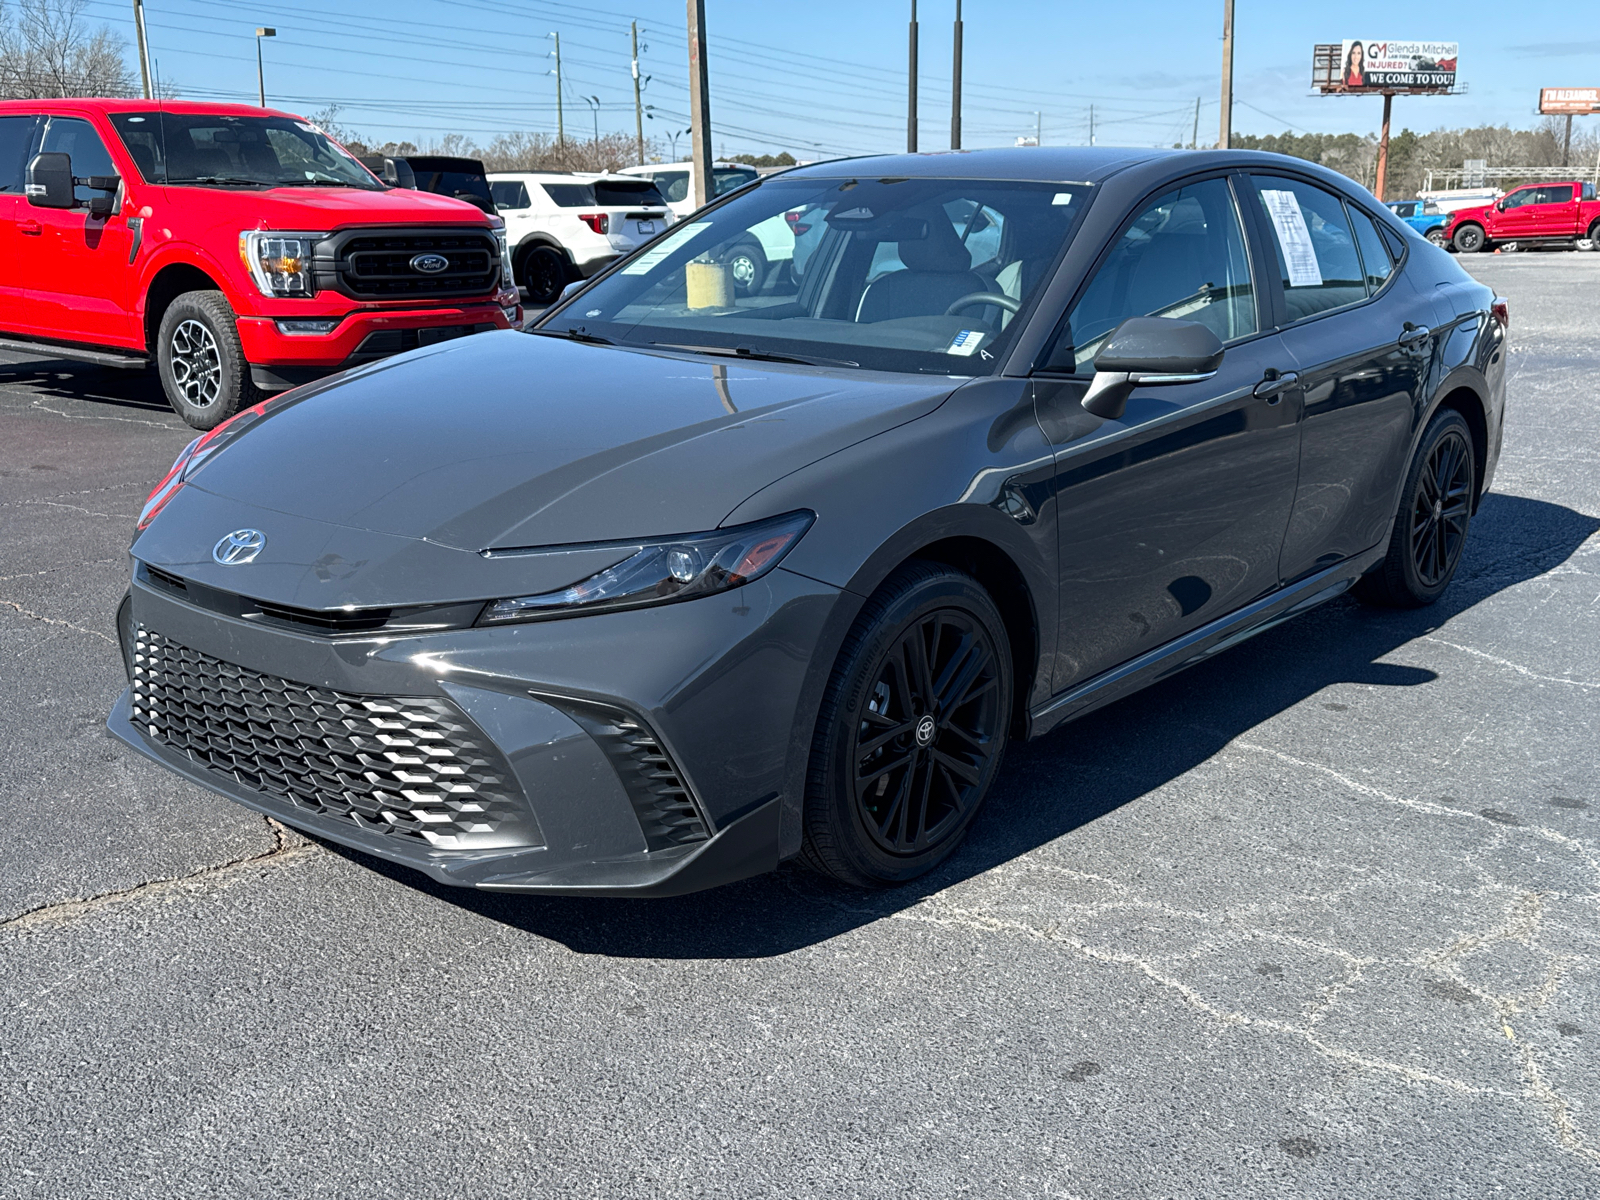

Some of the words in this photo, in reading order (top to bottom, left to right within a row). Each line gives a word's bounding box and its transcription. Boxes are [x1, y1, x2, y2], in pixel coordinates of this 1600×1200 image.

[1368, 43, 1387, 59] GM
[1388, 43, 1420, 54] Glenda
[1422, 44, 1458, 55] Mitchell
[1367, 61, 1408, 69] INJURED?
[1369, 73, 1385, 84] WE
[1386, 73, 1414, 84] COME
[1415, 73, 1430, 84] TO
[1431, 74, 1454, 84] YOU!
[980, 349, 994, 360] A
